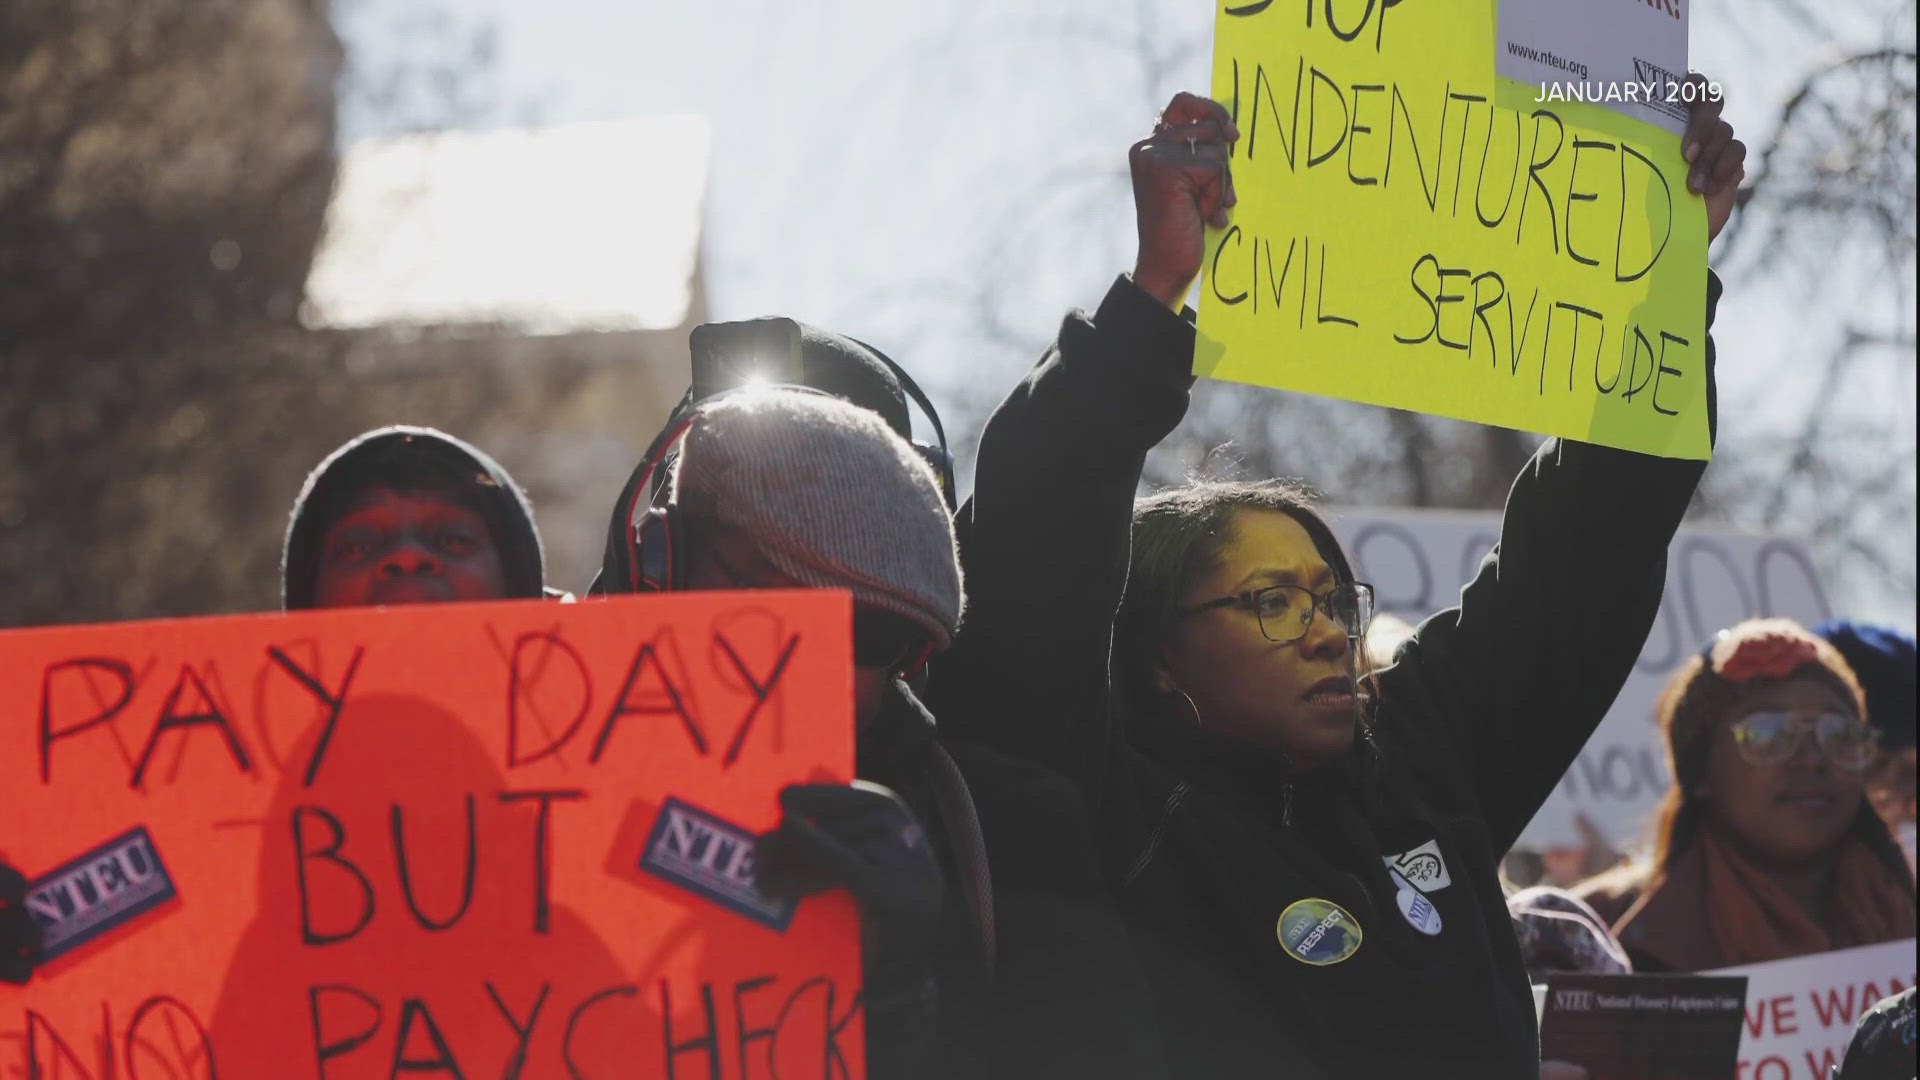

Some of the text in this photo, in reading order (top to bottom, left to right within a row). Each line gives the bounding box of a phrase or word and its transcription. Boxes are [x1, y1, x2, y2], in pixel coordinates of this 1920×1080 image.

[1225, 0, 1403, 53] OP
[1507, 41, 1588, 80] www.nteu.org
[1230, 55, 1672, 283] INDENTURED
[1211, 225, 1689, 416] CIVIL SERVITUDE
[39, 630, 800, 788] PAY DAY
[24, 836, 155, 926] NTEU
[292, 790, 588, 946] BUT
[653, 808, 757, 887] NTE
[1296, 908, 1345, 957] RESPECT
[25, 995, 217, 1080] NO
